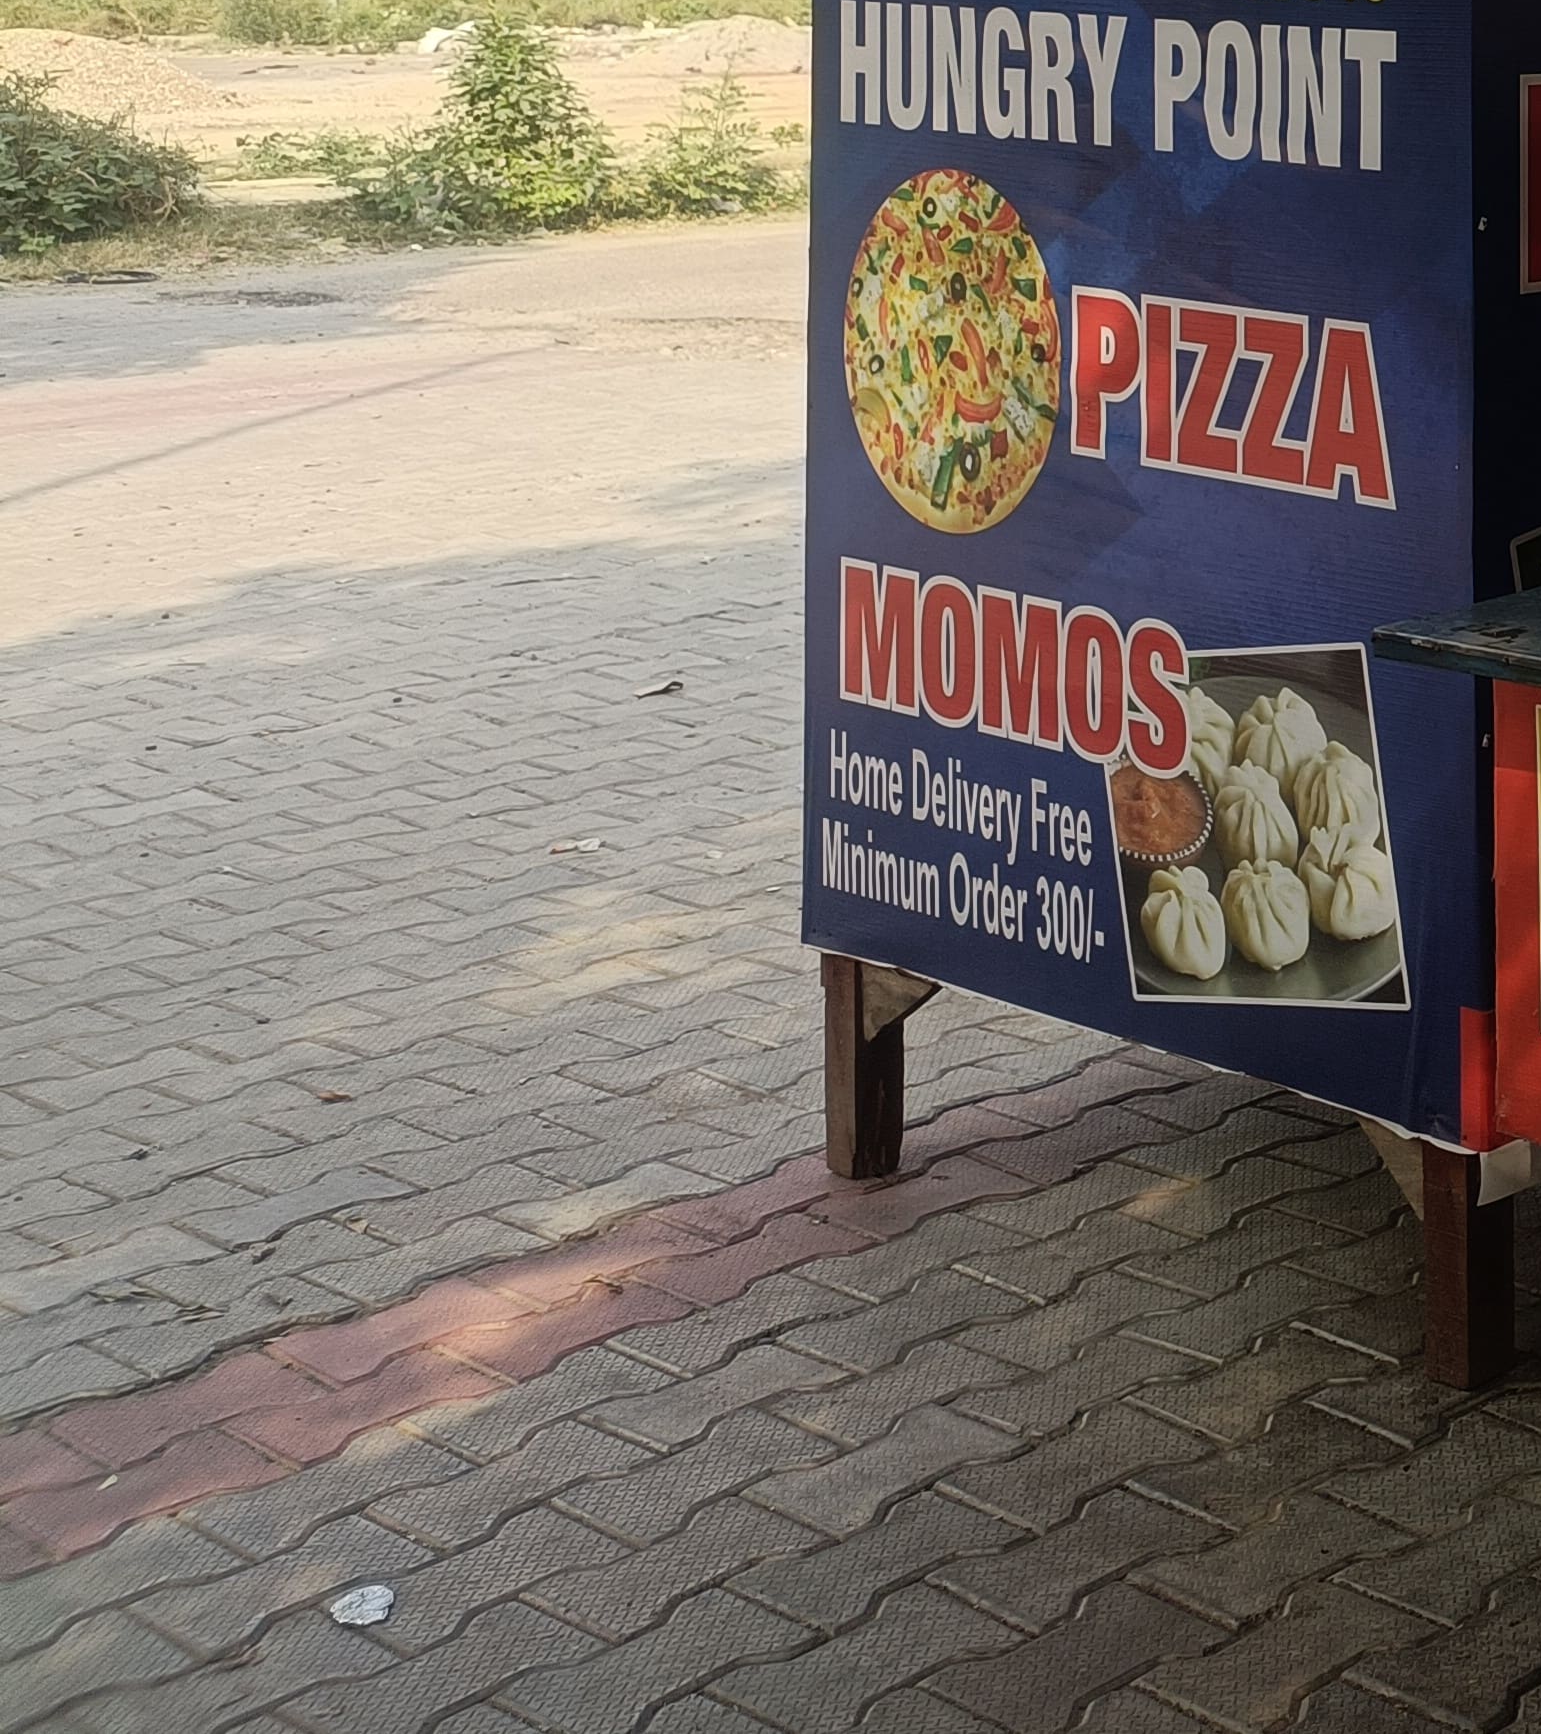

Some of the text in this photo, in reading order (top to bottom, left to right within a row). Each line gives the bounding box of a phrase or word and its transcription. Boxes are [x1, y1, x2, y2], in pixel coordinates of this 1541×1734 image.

[839, 0, 1397, 171] HUNGRY POINT
[1070, 285, 1397, 511] PIZZA
[839, 556, 1192, 779] MOMOS
[829, 729, 1092, 867] Home Delivery Free
[822, 818, 1106, 964] Minimum Order 300/-
